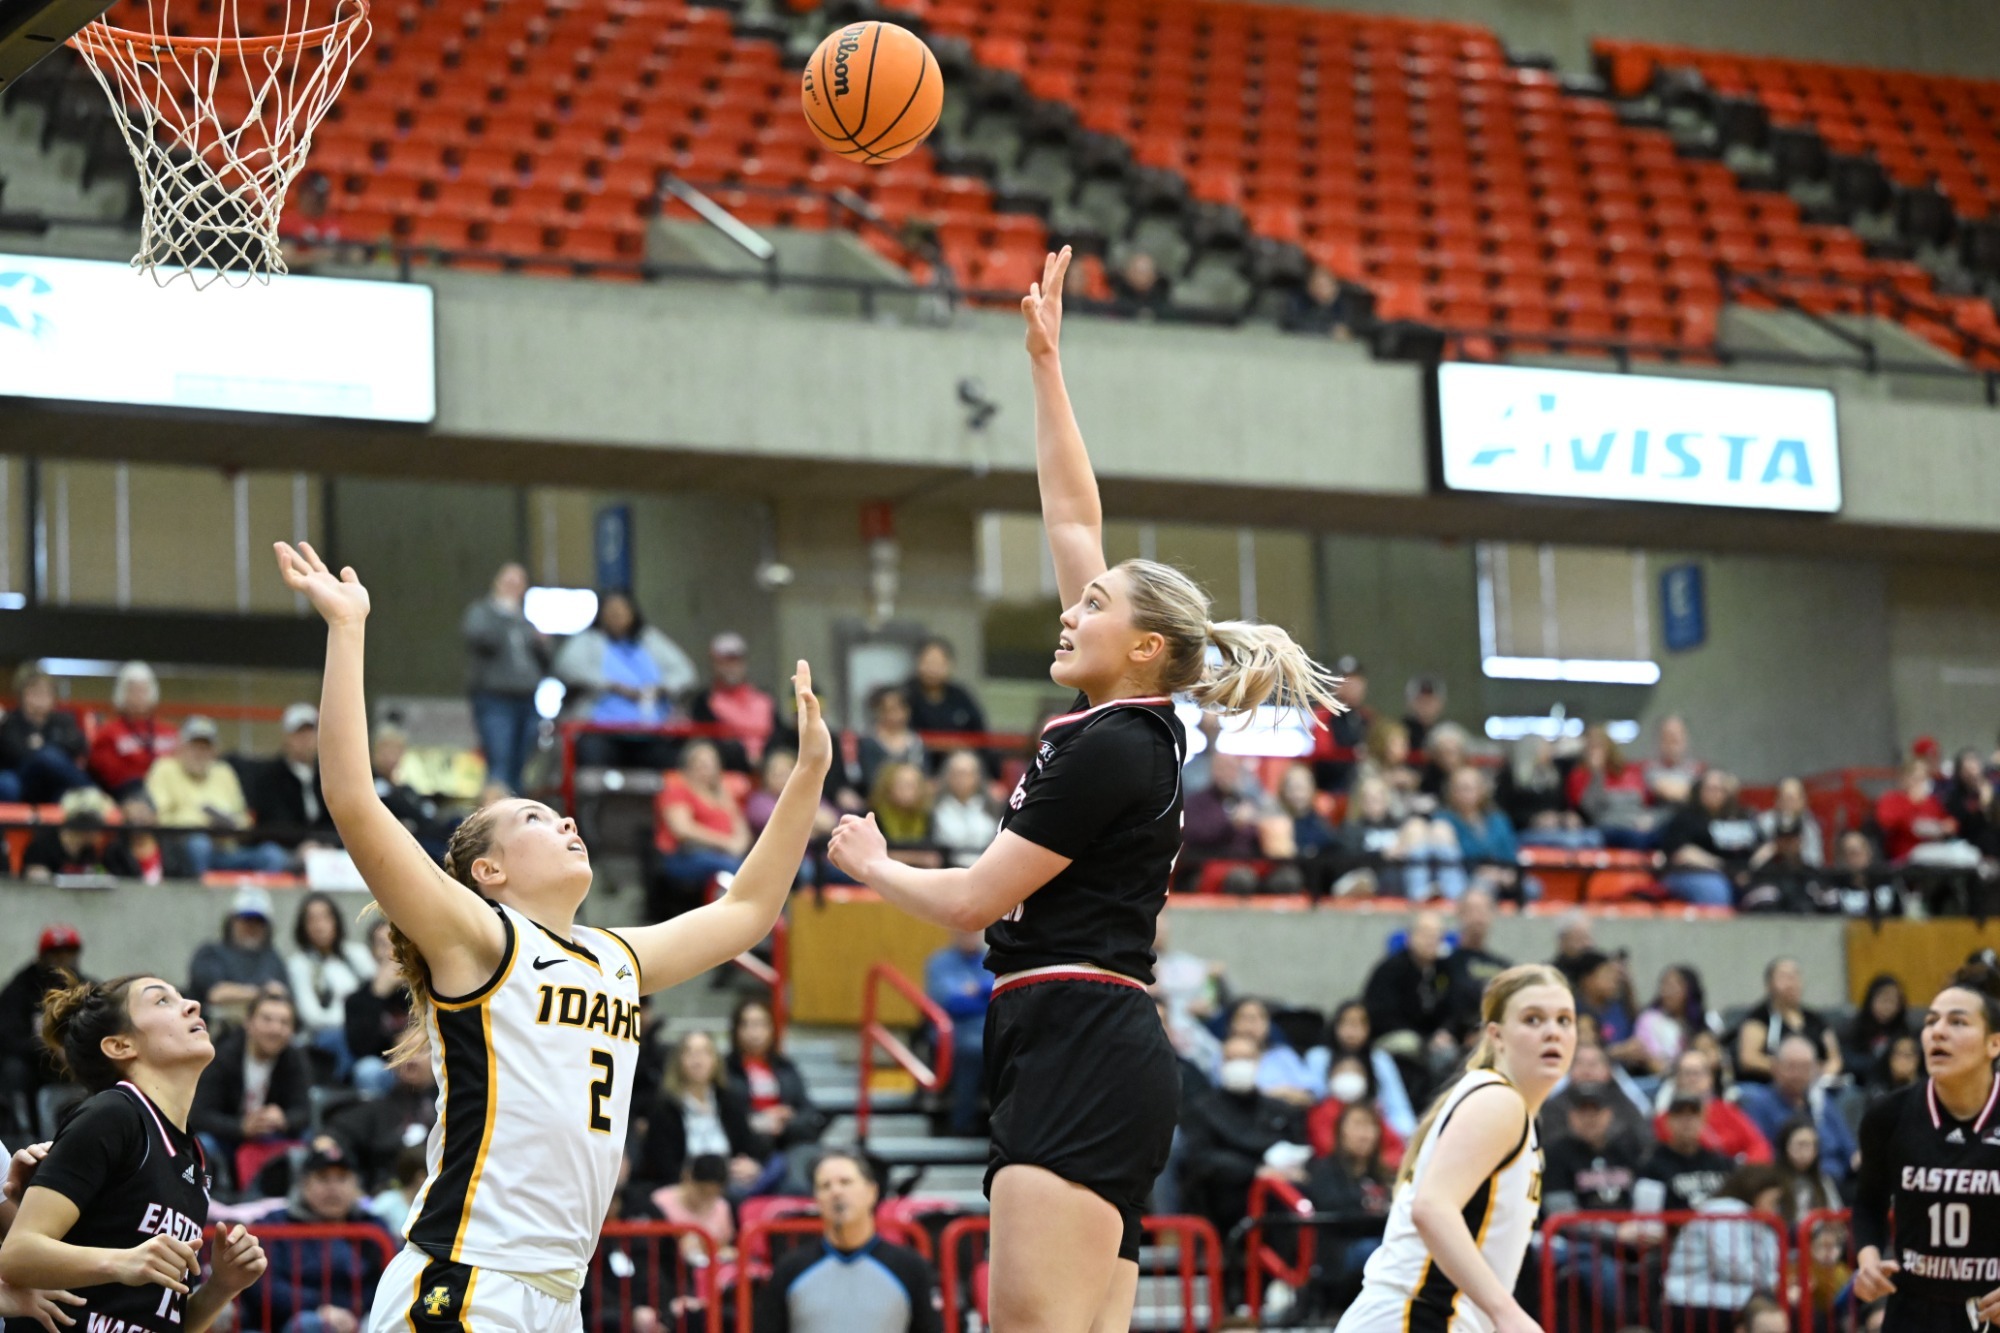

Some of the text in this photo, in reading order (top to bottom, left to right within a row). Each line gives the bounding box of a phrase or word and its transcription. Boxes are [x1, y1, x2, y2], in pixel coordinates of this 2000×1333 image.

[834, 24, 868, 98] Wilson
[588, 1047, 614, 1135] 2
[1901, 1165, 2000, 1195] EASTERN
[1927, 1202, 1970, 1248] 10
